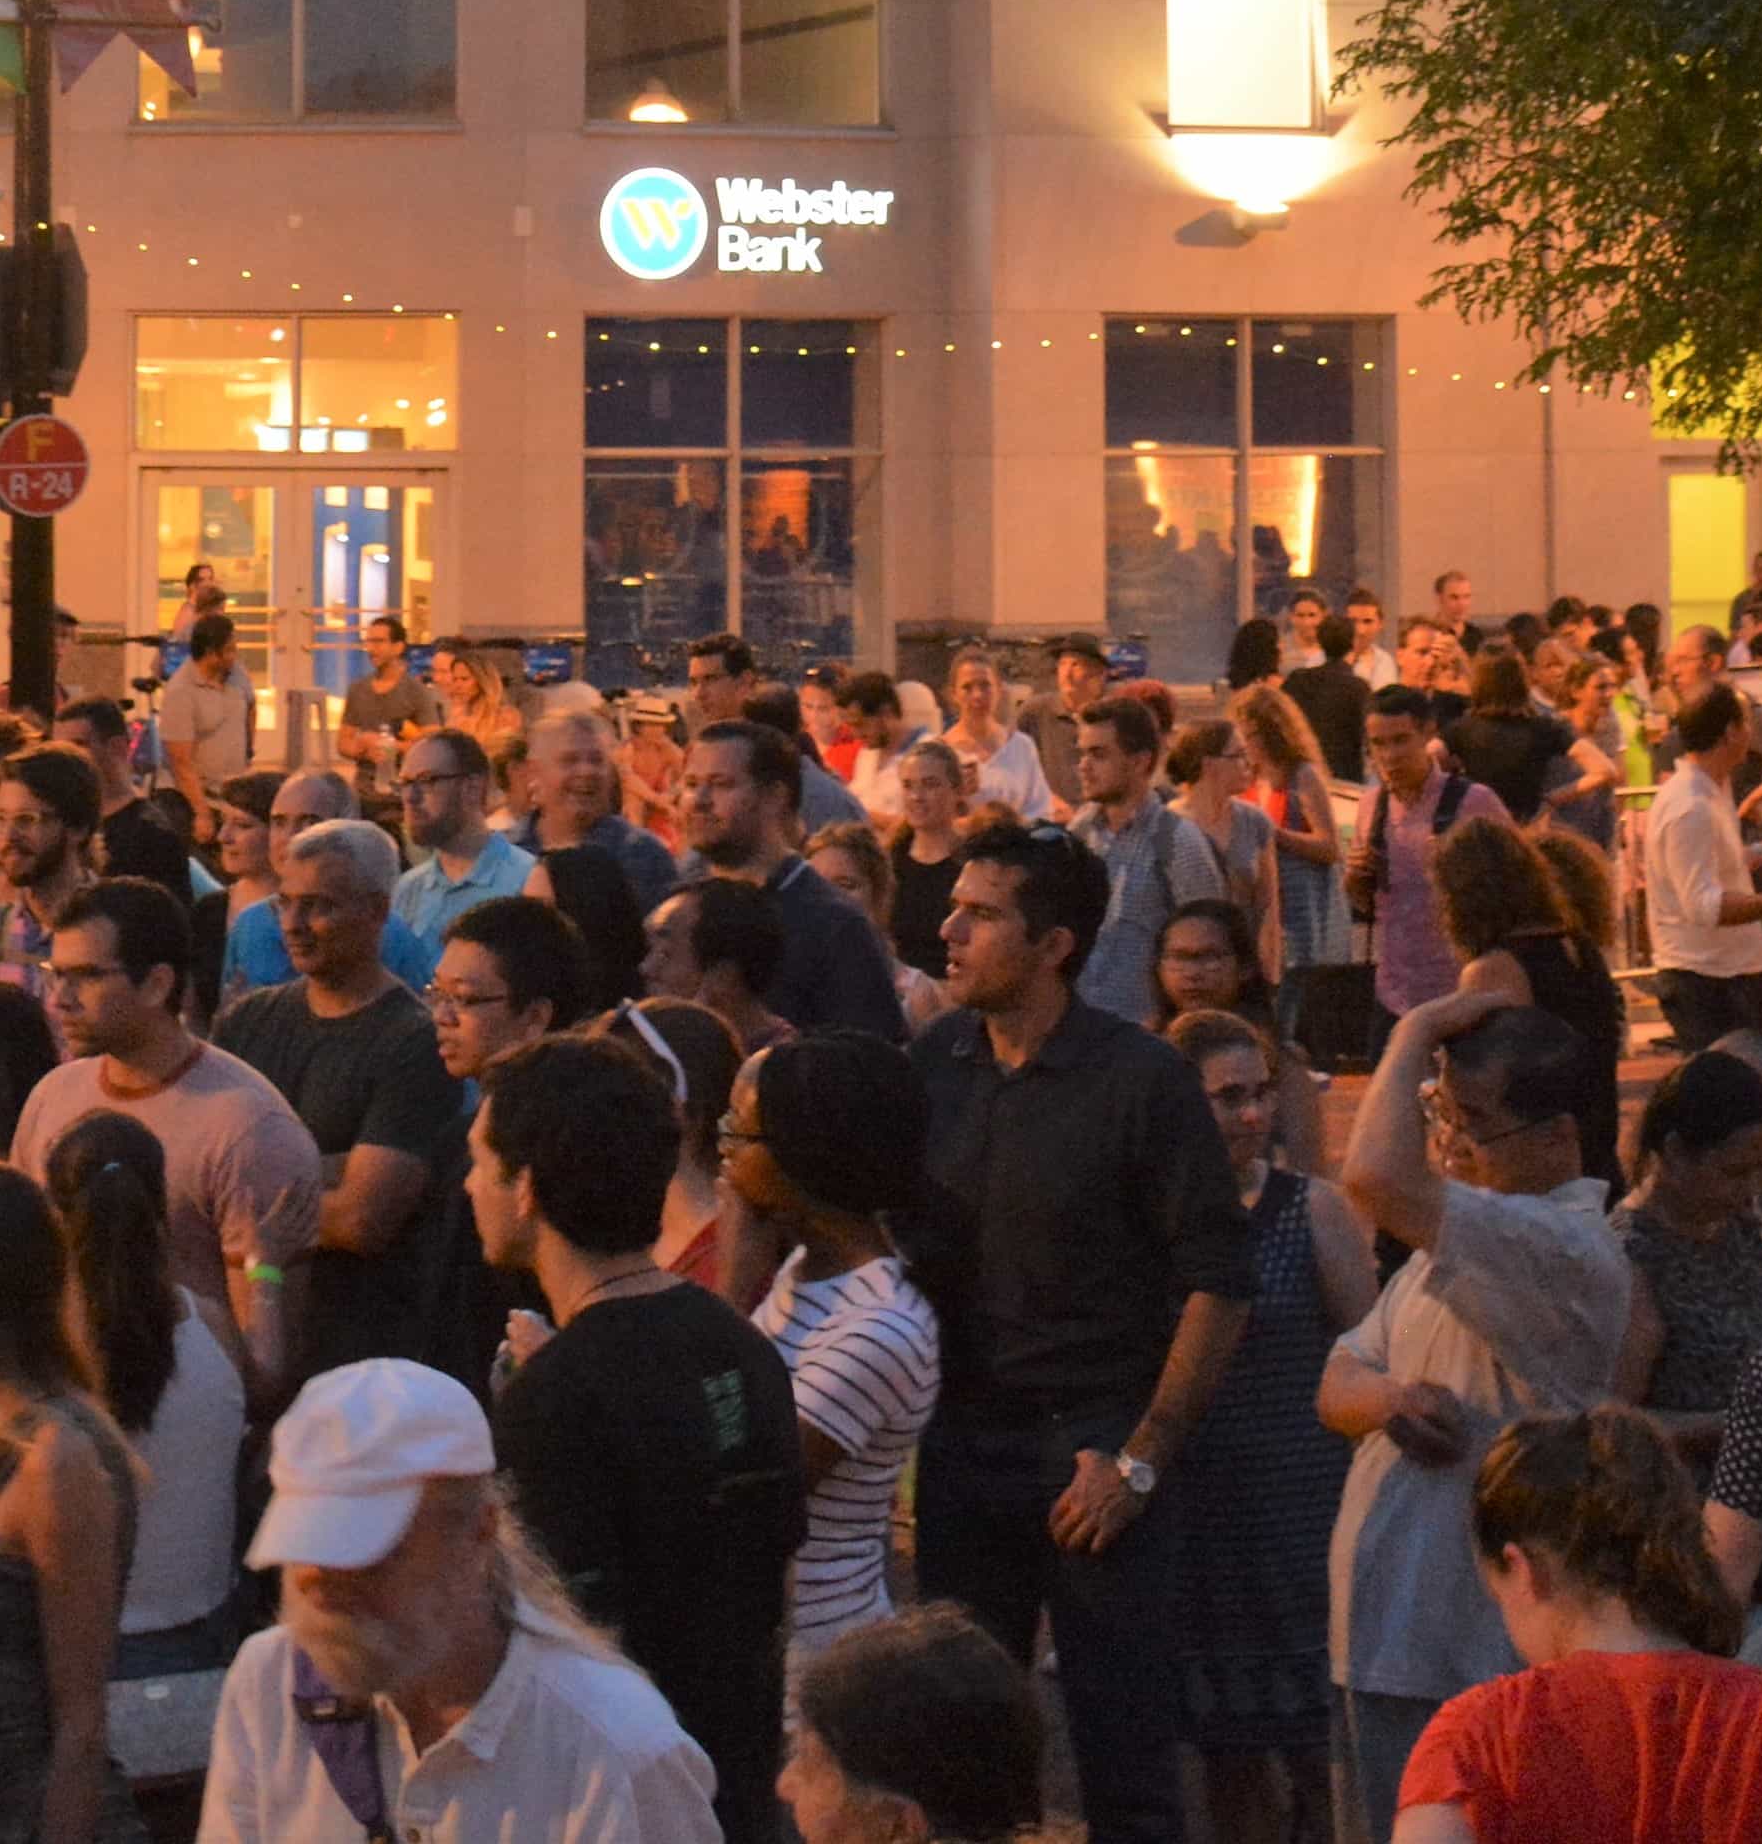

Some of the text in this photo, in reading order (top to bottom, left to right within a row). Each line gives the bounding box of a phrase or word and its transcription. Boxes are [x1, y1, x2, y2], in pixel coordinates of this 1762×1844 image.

[715, 177, 894, 225] Webster
[717, 225, 823, 272] Bank
[27, 421, 56, 462] F
[10, 471, 74, 501] R-24
